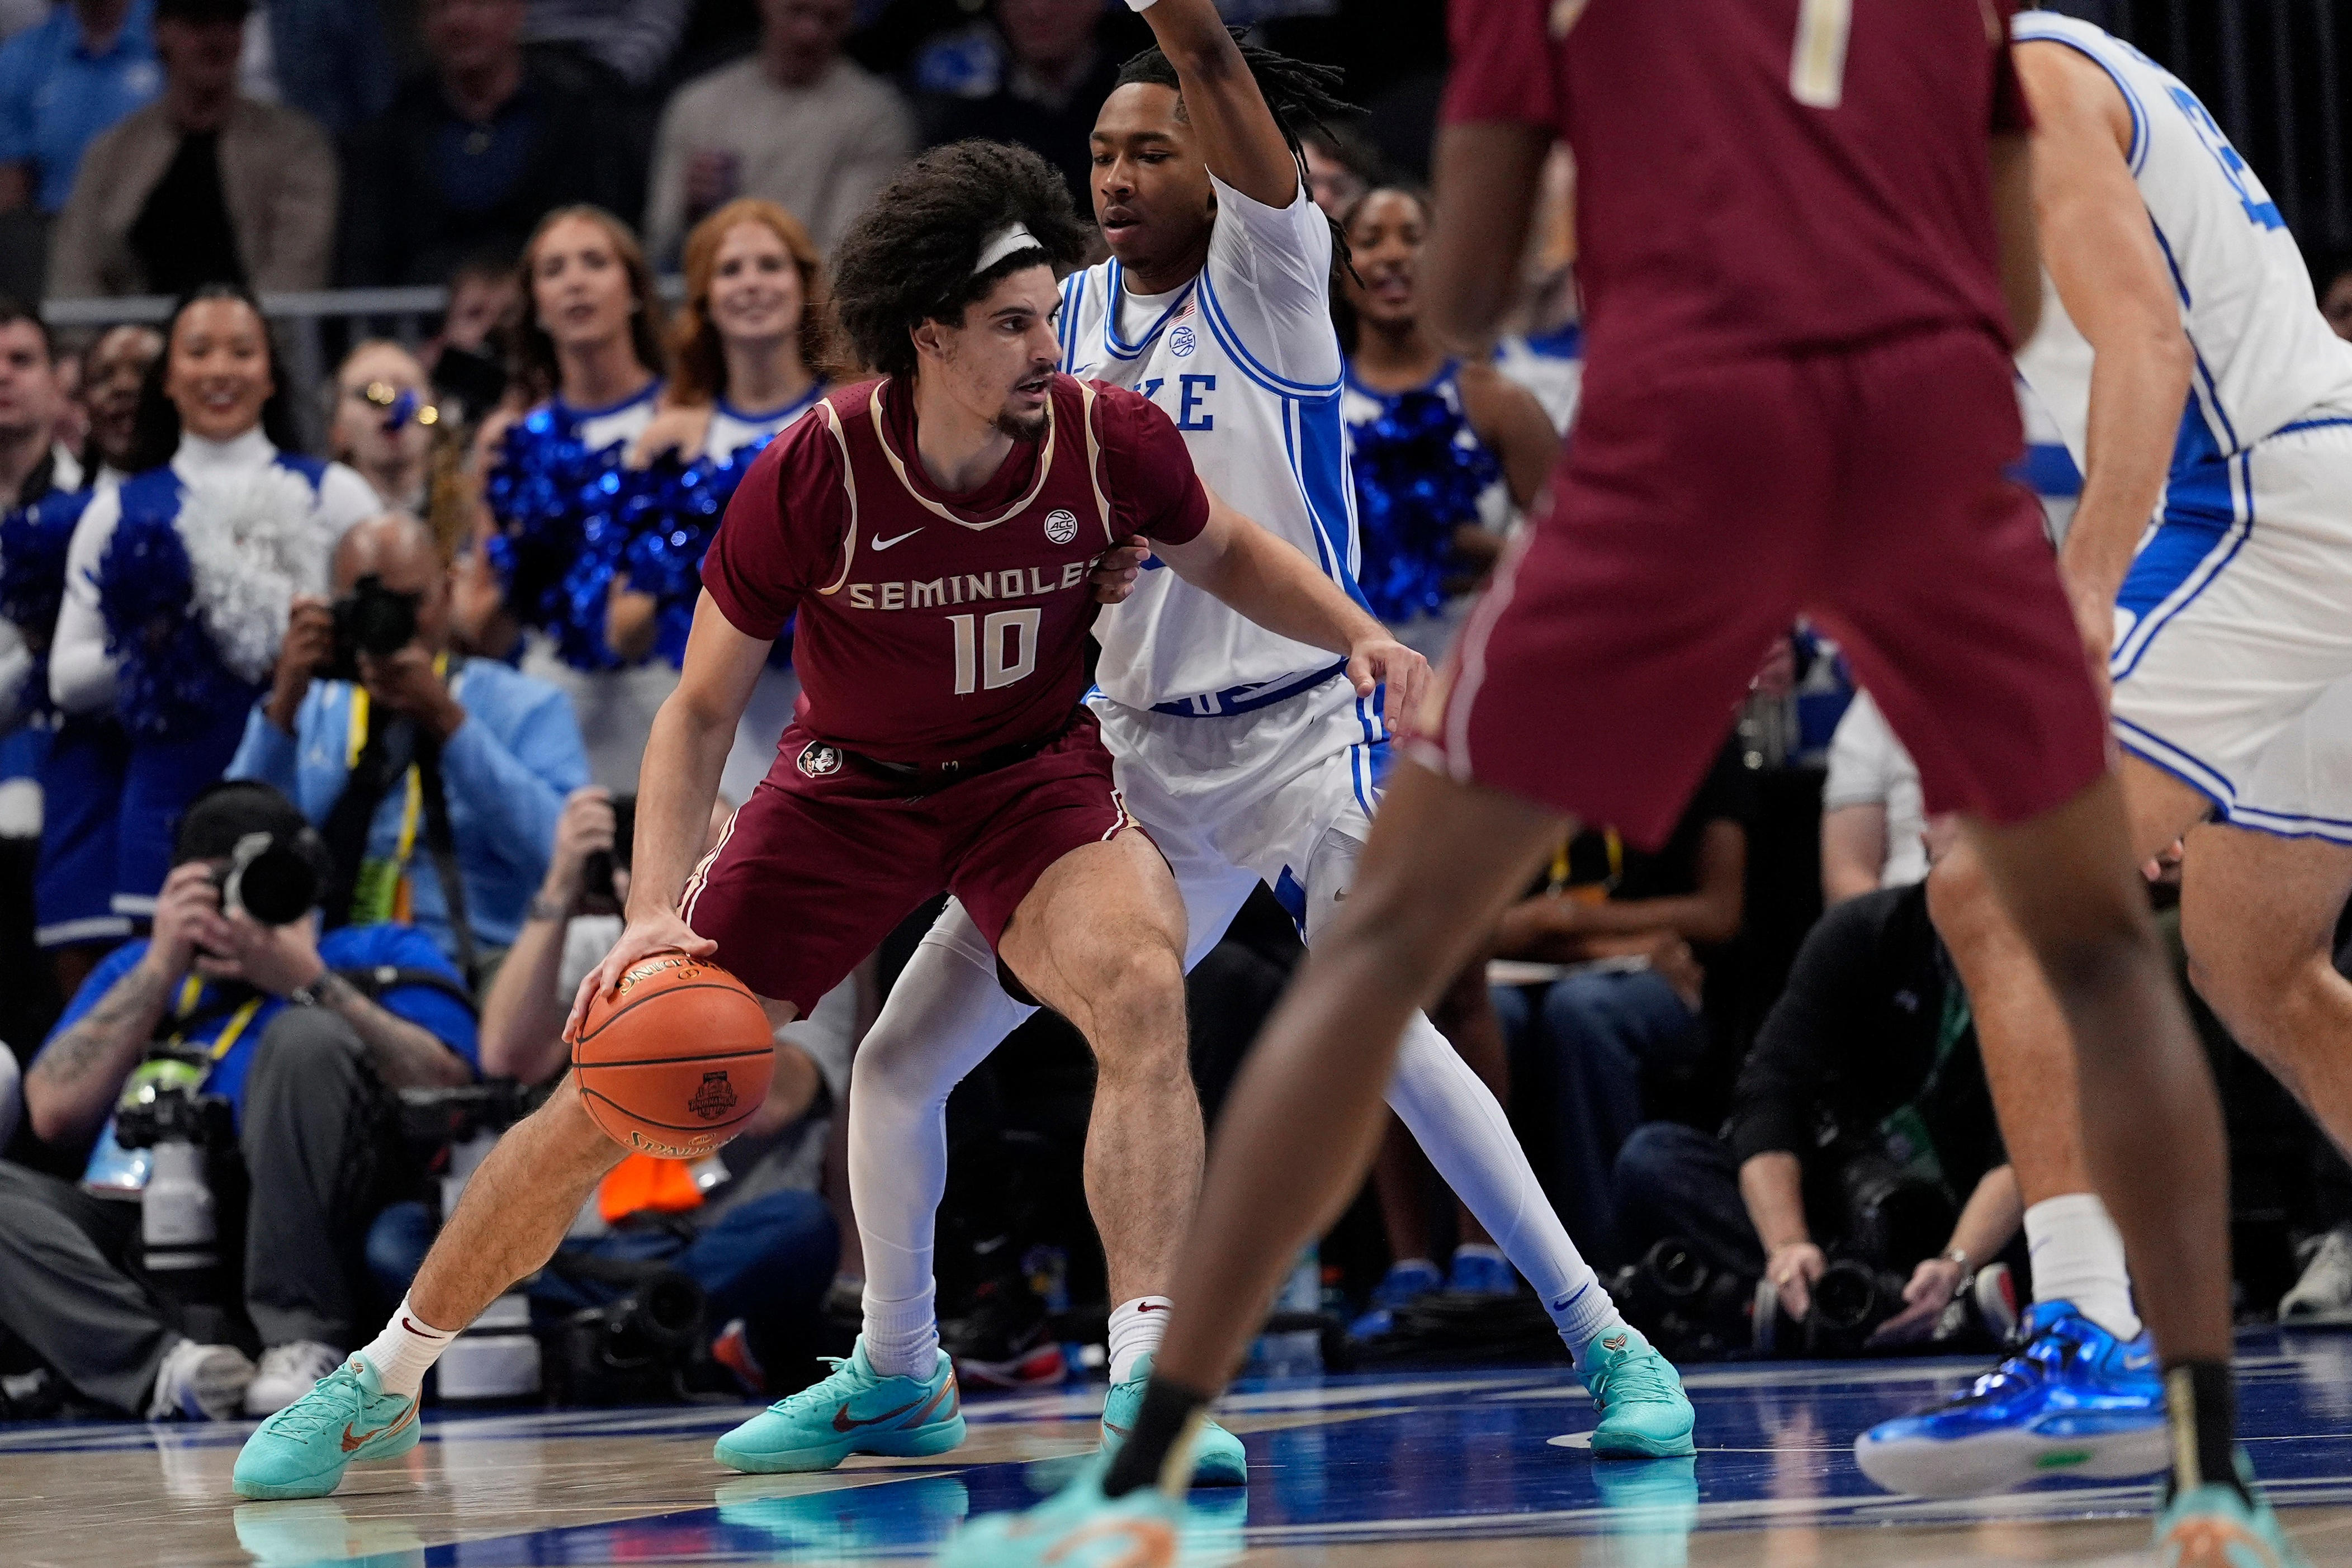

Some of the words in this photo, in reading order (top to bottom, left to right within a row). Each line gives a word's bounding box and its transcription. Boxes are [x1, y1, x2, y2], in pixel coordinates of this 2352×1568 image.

[1173, 333, 1194, 346] ACC
[1049, 519, 1074, 530] ACC
[944, 608, 1042, 695] 10
